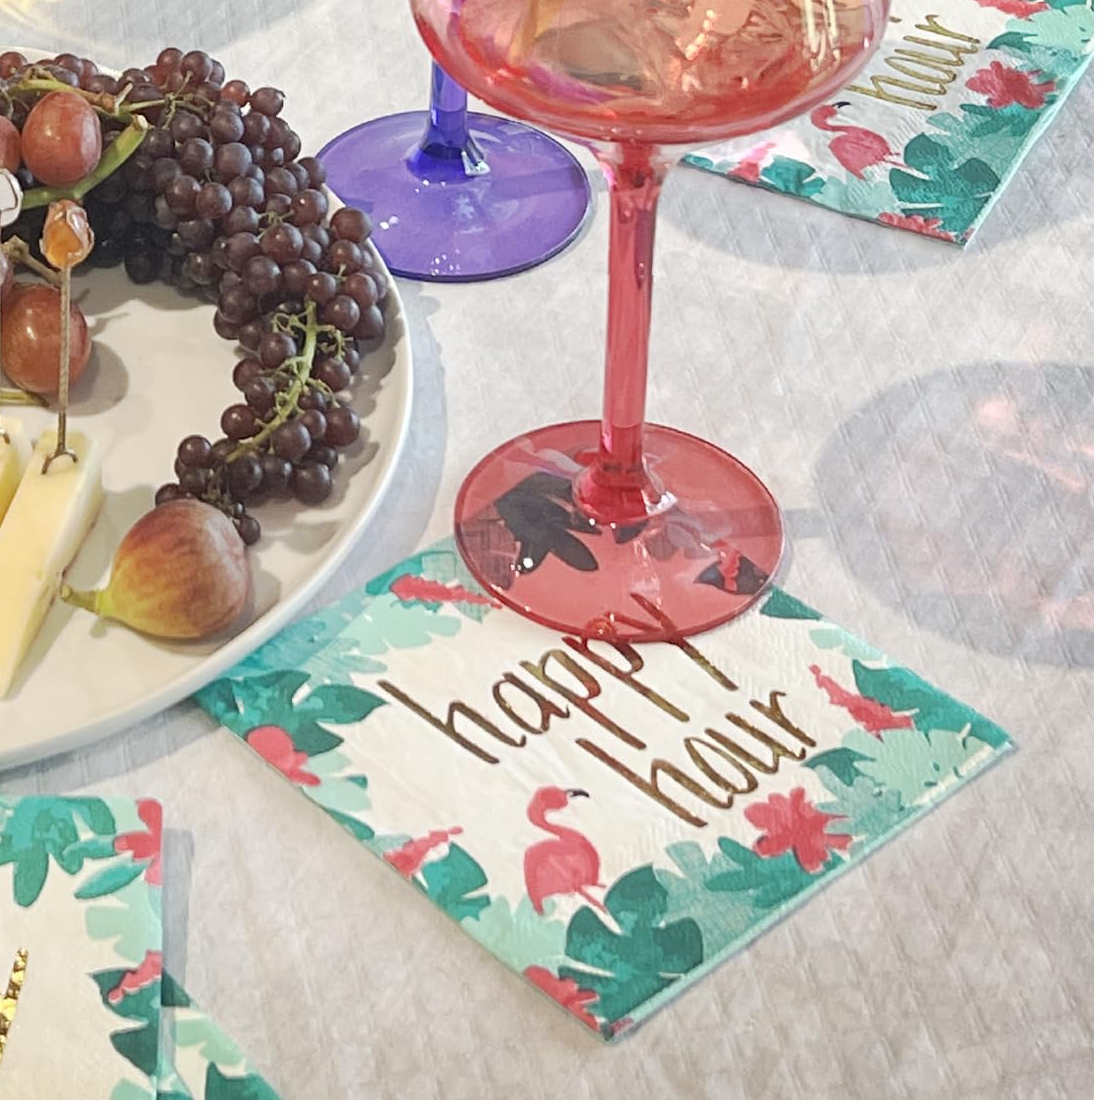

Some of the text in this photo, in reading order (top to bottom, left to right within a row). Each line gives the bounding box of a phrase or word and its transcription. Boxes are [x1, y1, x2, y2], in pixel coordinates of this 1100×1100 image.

[844, 14, 980, 111] hour
[377, 594, 738, 764] happy
[576, 691, 816, 827] hour
